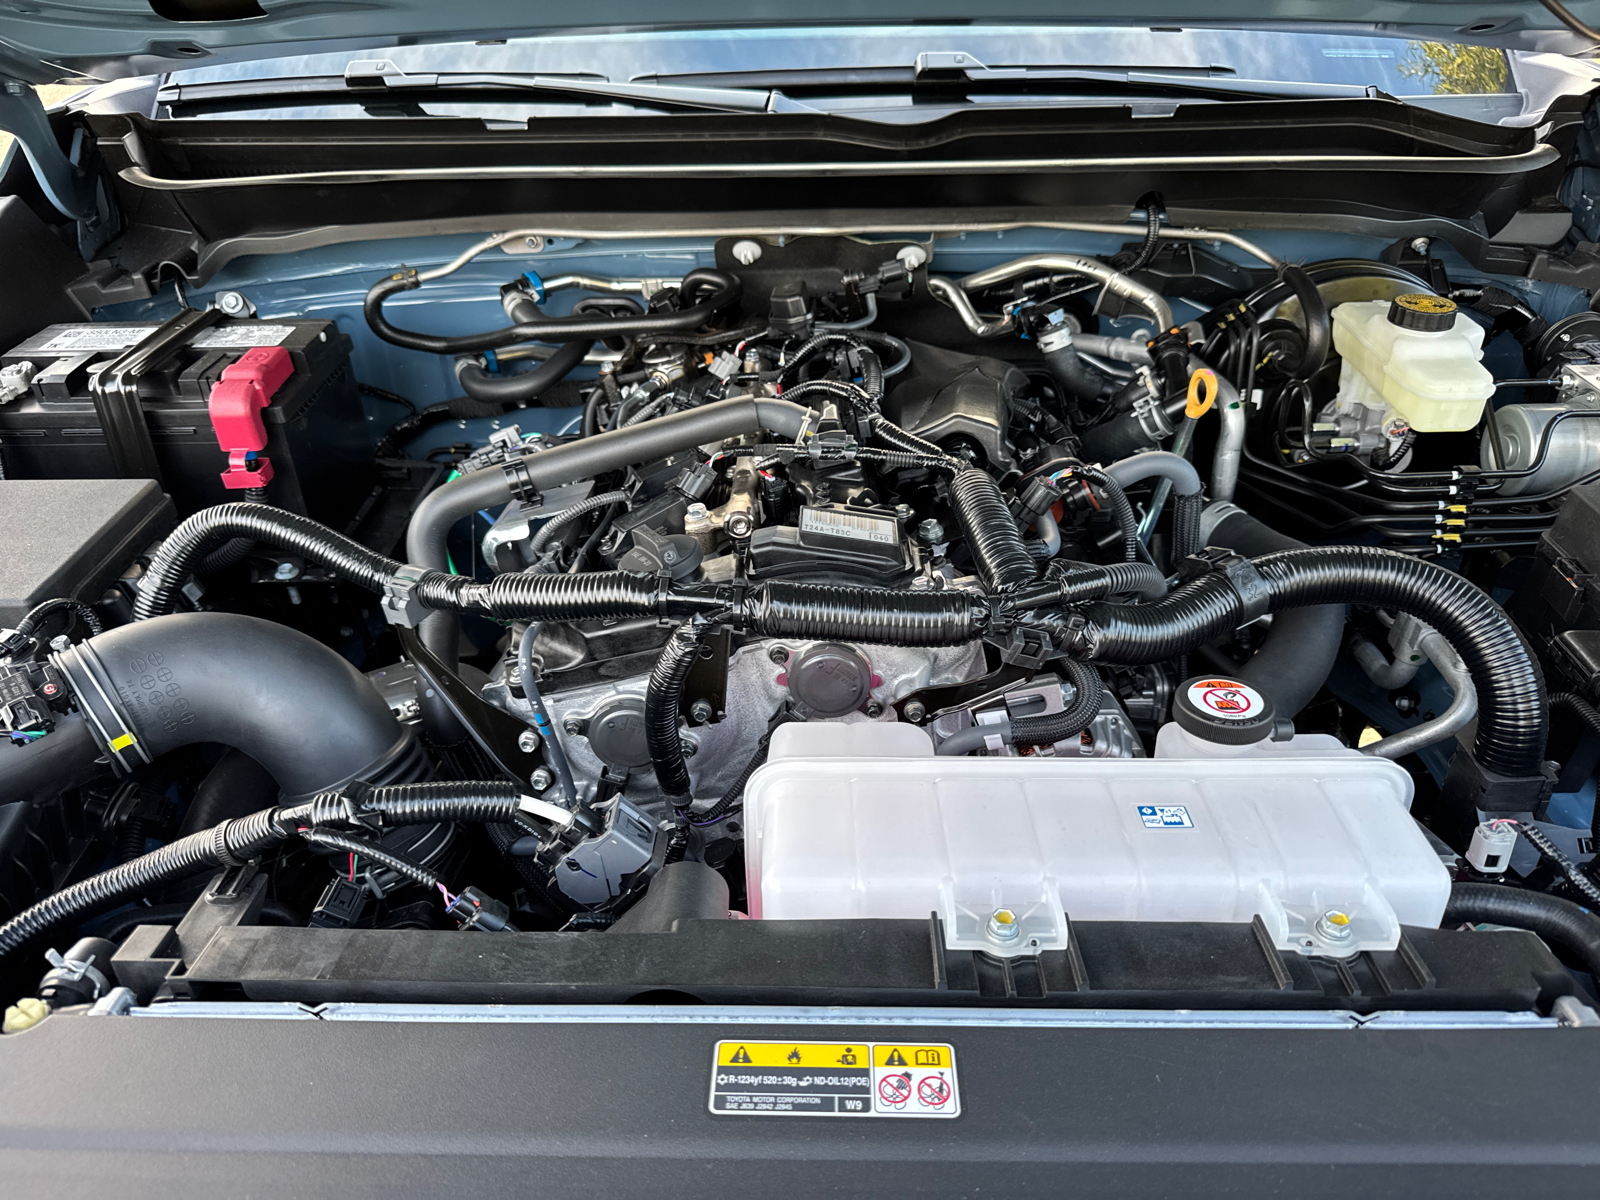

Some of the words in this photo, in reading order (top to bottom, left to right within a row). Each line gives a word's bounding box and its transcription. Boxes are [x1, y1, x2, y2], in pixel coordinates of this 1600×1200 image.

[804, 523, 851, 536] T24A-T83C
[728, 1075, 762, 1086] R-1234yf
[762, 1076, 797, 1087] 520±30g
[813, 1076, 869, 1087] ND-OIL12(POE)
[845, 1100, 862, 1110] W9
